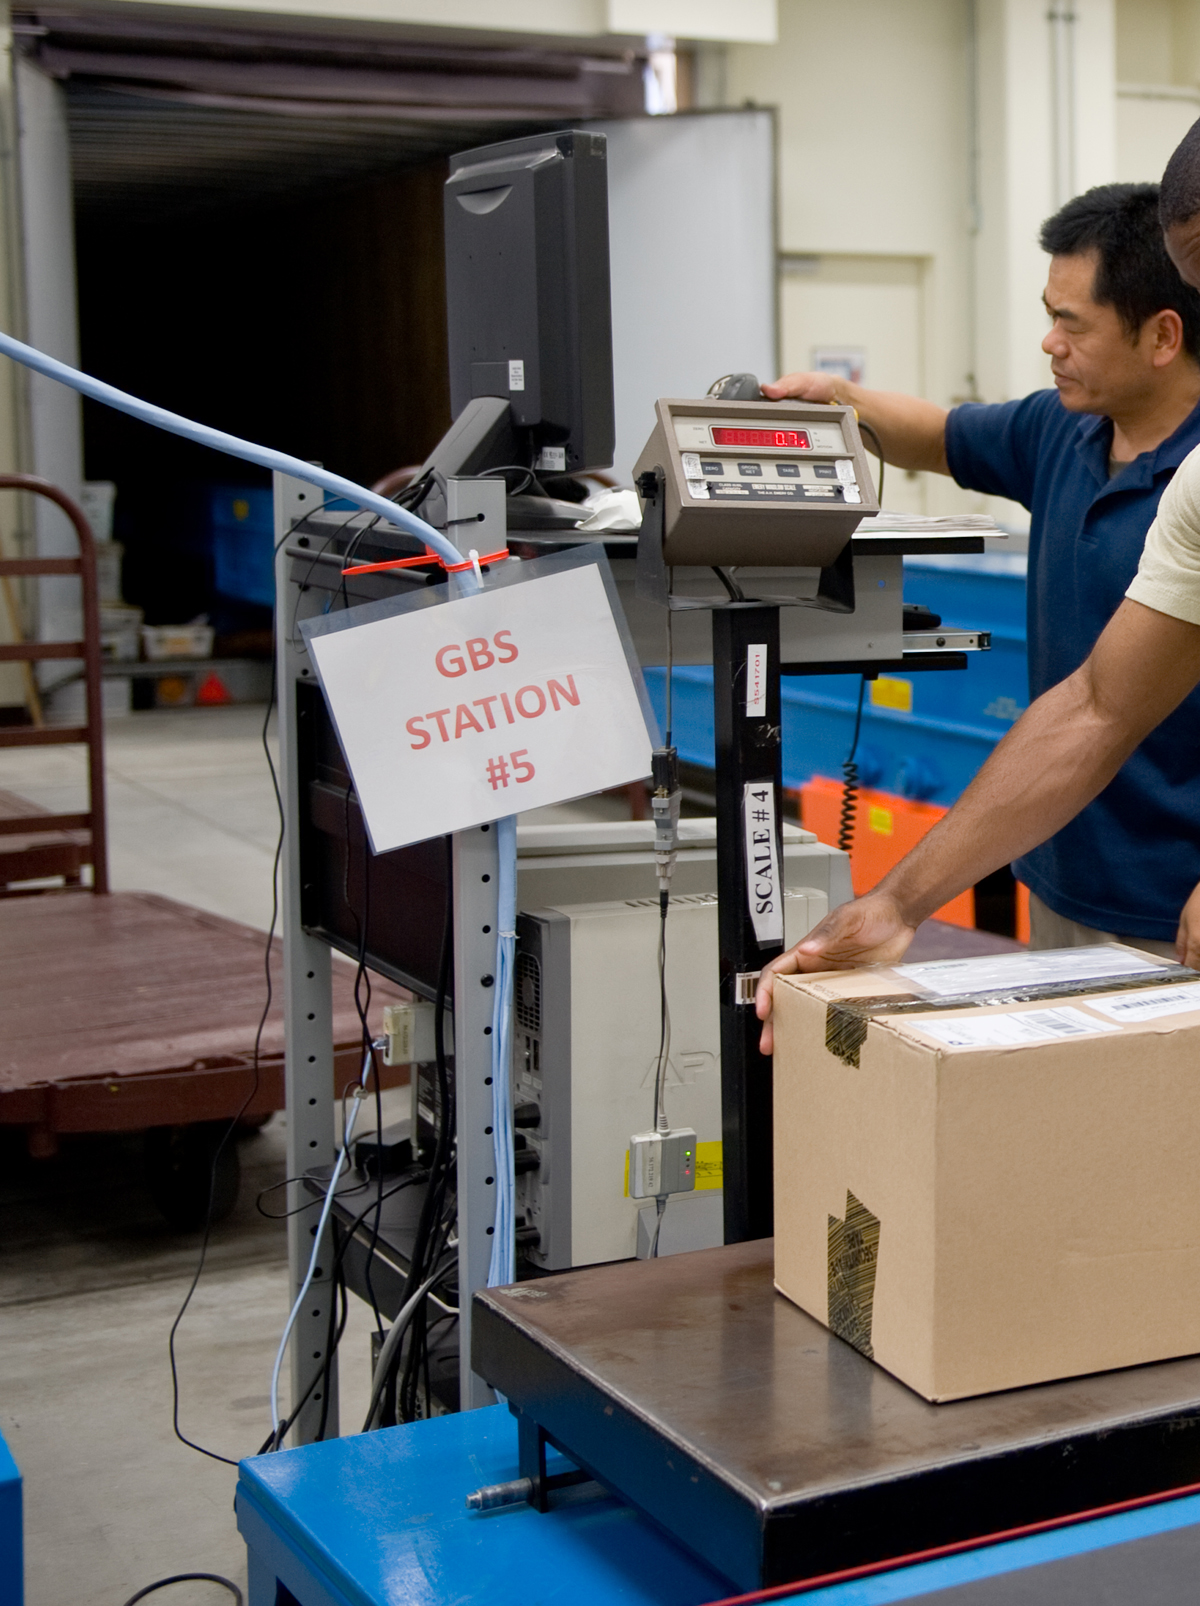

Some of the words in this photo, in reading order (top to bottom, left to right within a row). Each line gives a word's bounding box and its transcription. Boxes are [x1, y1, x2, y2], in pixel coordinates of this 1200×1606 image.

[435, 630, 519, 678] GBS
[405, 674, 581, 750] STATION
[485, 748, 536, 791] #5
[751, 790, 769, 802] 4
[751, 808, 770, 822] #
[752, 828, 774, 914] SCALE
[640, 1051, 721, 1089] AP
